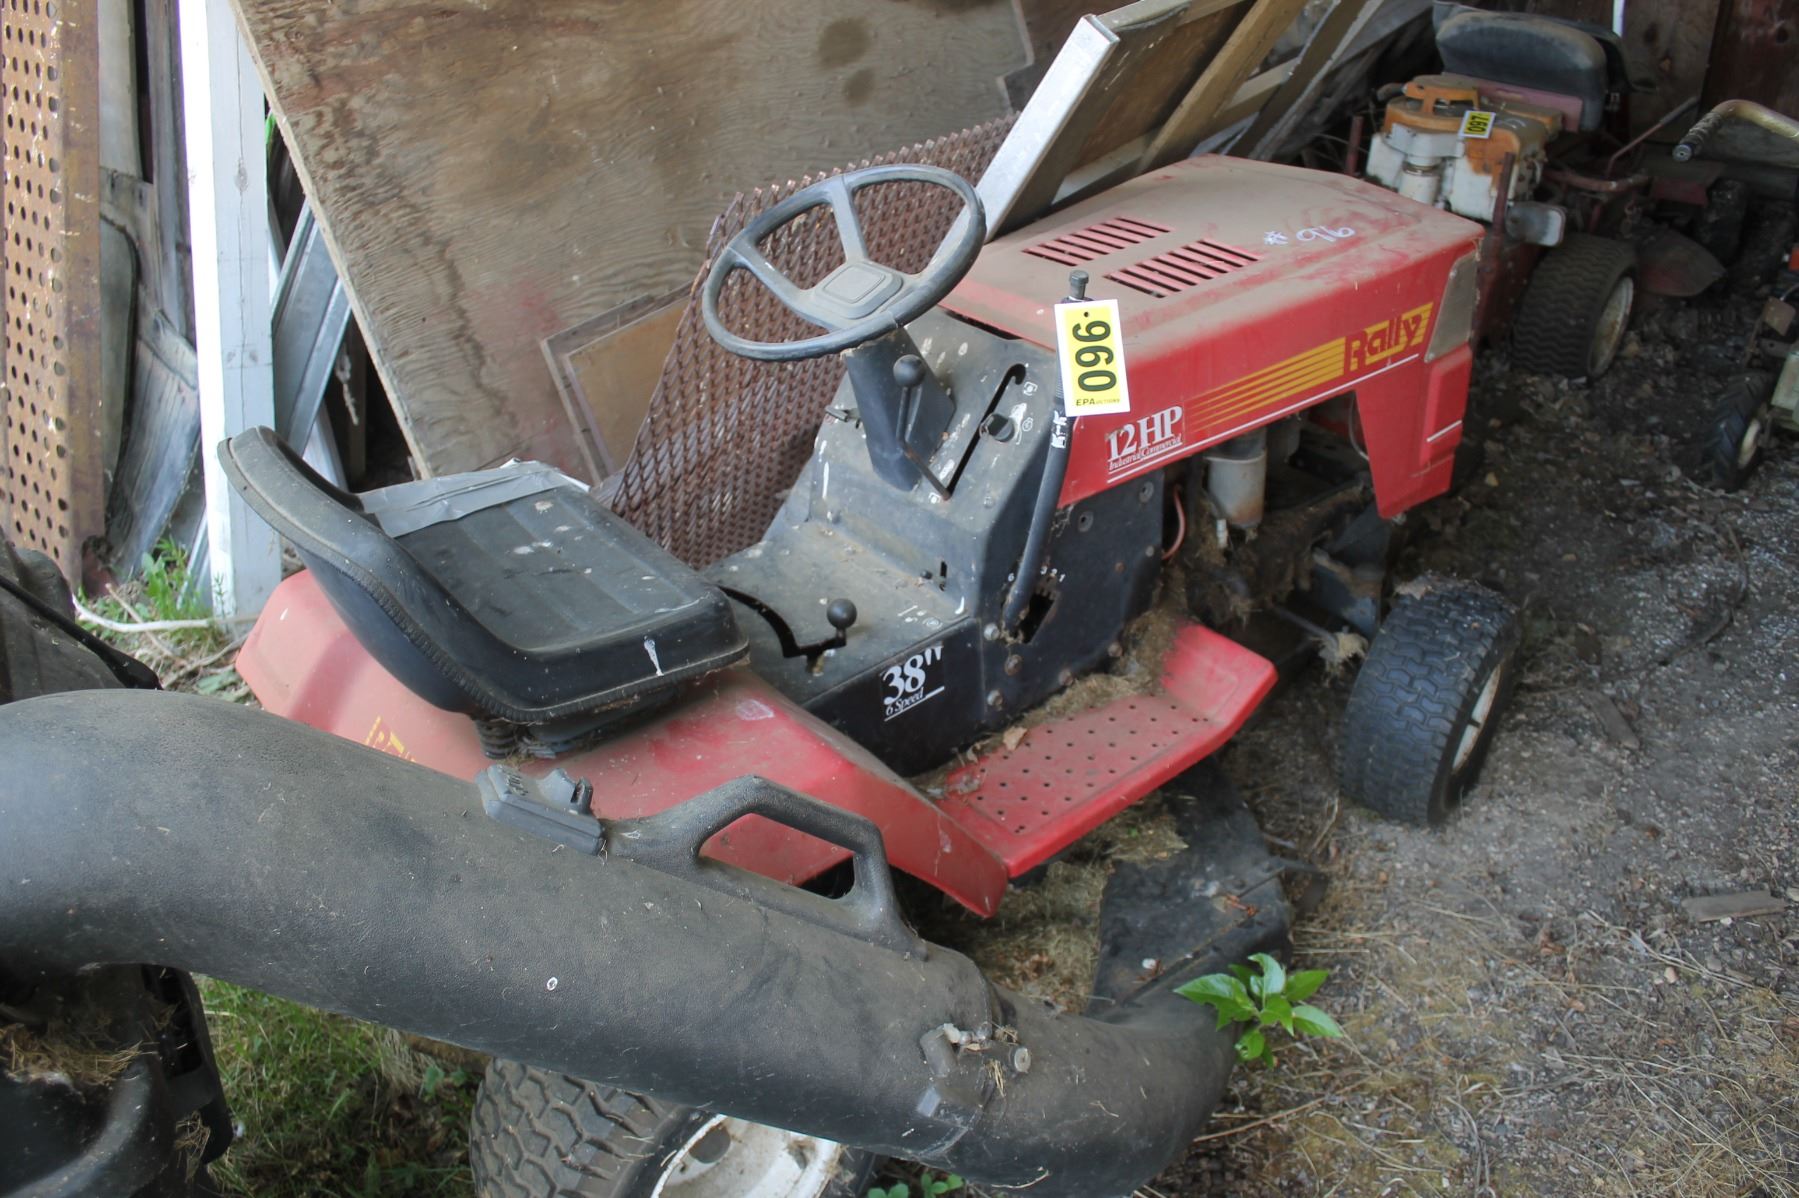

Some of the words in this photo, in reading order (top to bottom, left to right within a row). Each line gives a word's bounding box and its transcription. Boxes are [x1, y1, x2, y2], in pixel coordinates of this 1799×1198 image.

[1344, 313, 1423, 373] Rally
[885, 703, 894, 716] 6
[894, 686, 924, 712] Speed
